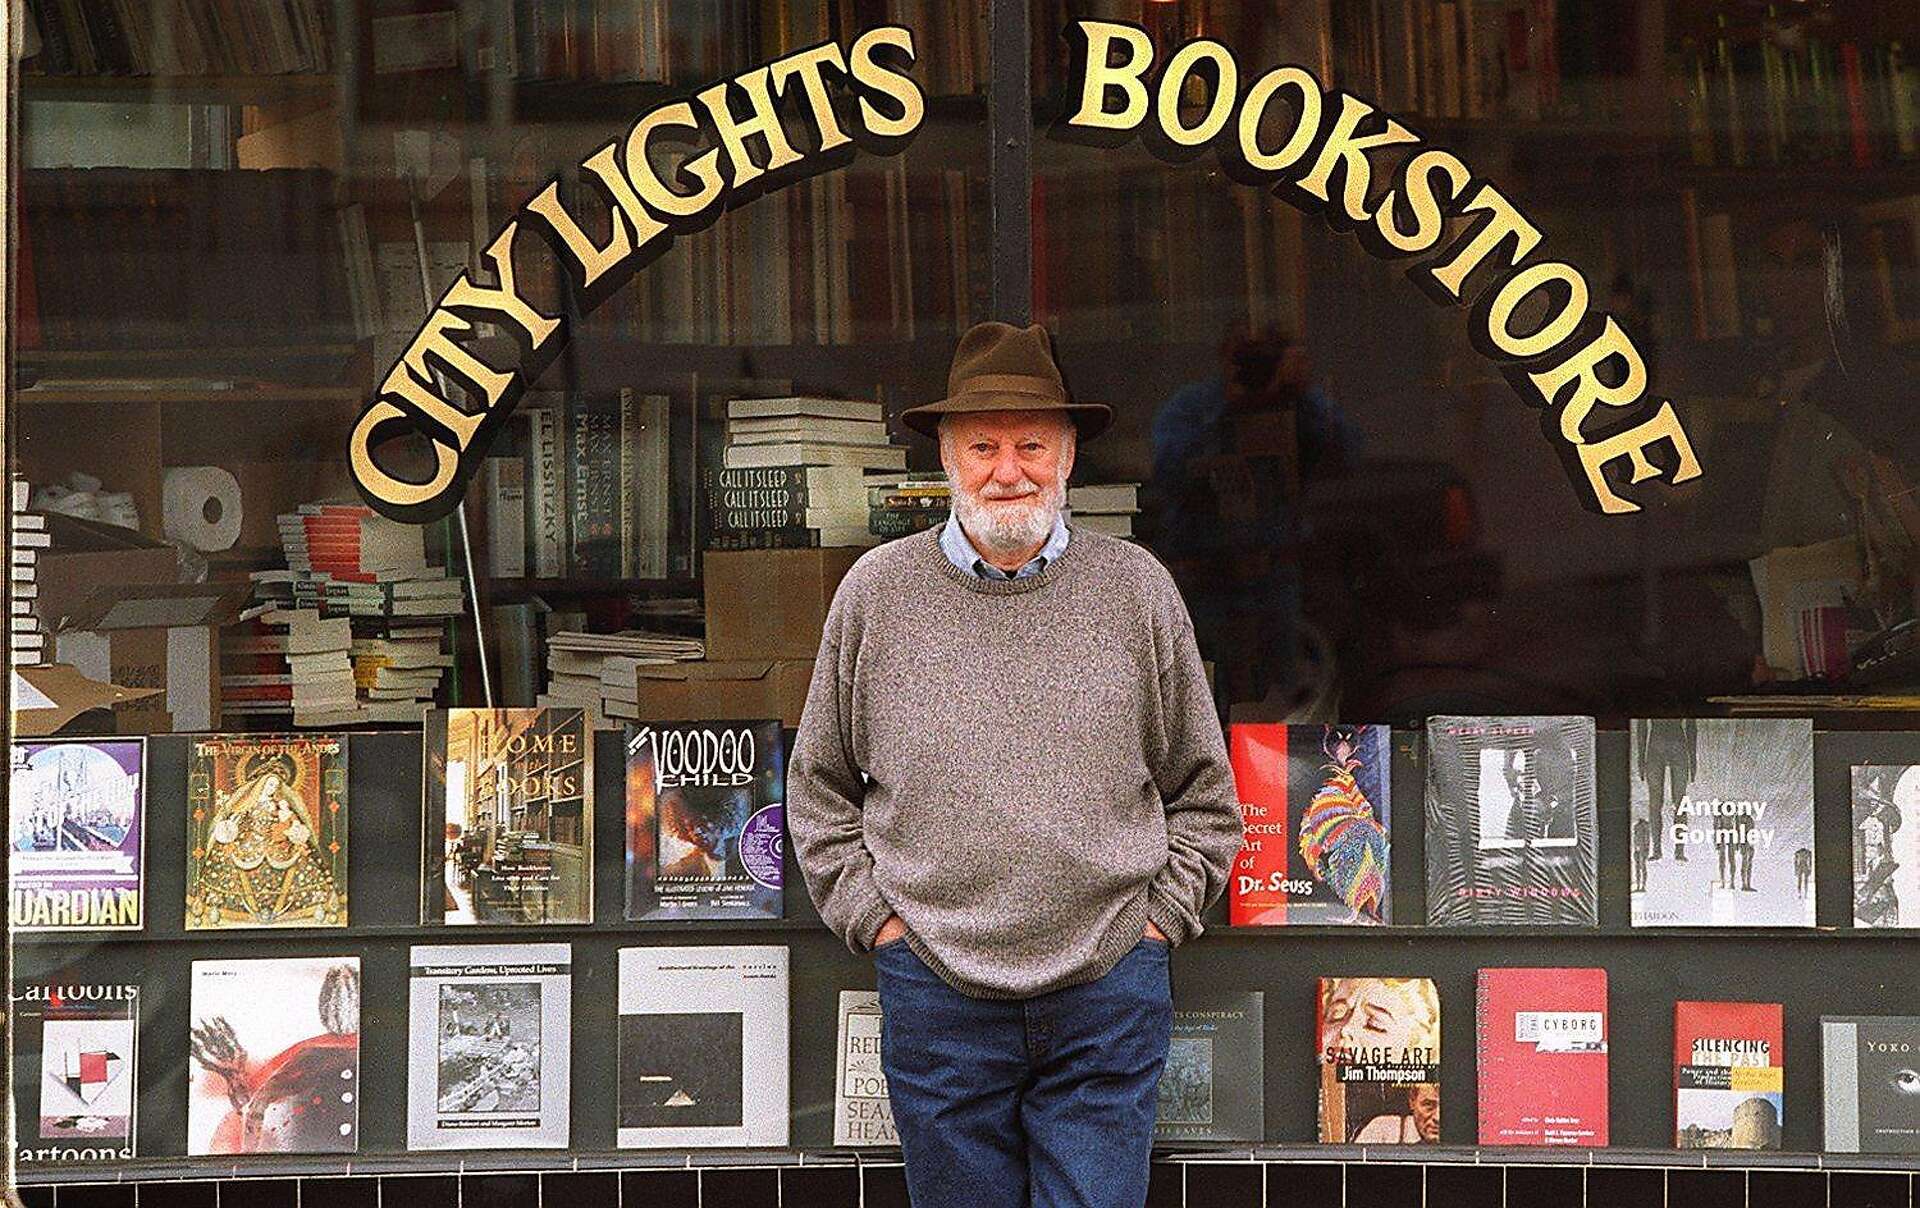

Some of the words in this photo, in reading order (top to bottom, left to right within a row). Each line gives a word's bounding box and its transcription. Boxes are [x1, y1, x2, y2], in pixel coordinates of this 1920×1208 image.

[350, 221, 561, 505] CITY
[527, 27, 924, 287] LIGHTS
[1069, 21, 1703, 514] BOOKSTORE
[719, 470, 742, 488] CALL
[744, 470, 754, 488] IT
[756, 470, 787, 488] SLEEP
[542, 441, 557, 543] LISSITZKY
[724, 490, 745, 508] CALL
[749, 490, 758, 508] IT
[760, 490, 790, 508] SLEEP
[727, 510, 748, 528] CALL
[751, 510, 760, 528] IT
[761, 510, 789, 528] SLEEP
[649, 729, 755, 795] VOODOO
[659, 773, 755, 788] CHILD
[1240, 803, 1268, 817] The
[1676, 796, 1768, 821] Antony
[1242, 822, 1282, 834] Secret
[1669, 823, 1775, 847] Gormley
[1240, 840, 1262, 852] Art
[1240, 856, 1255, 869] of
[1238, 875, 1265, 896] Dr.
[1268, 871, 1313, 896] Seuss
[13, 888, 138, 926] UARDIAN
[1186, 1011, 1244, 1020] CONSPIRACY
[1544, 1019, 1597, 1031] CYBORG
[1692, 1038, 1770, 1054] SILENCING
[1867, 1041, 1910, 1053] YOKO
[1326, 1046, 1392, 1065] SAVAGE
[1401, 1047, 1433, 1065] ART
[1341, 1066, 1364, 1081] Jim
[1366, 1066, 1426, 1084] Thompson
[847, 1102, 895, 1120] SEA
[16, 1144, 132, 1161] artoons
